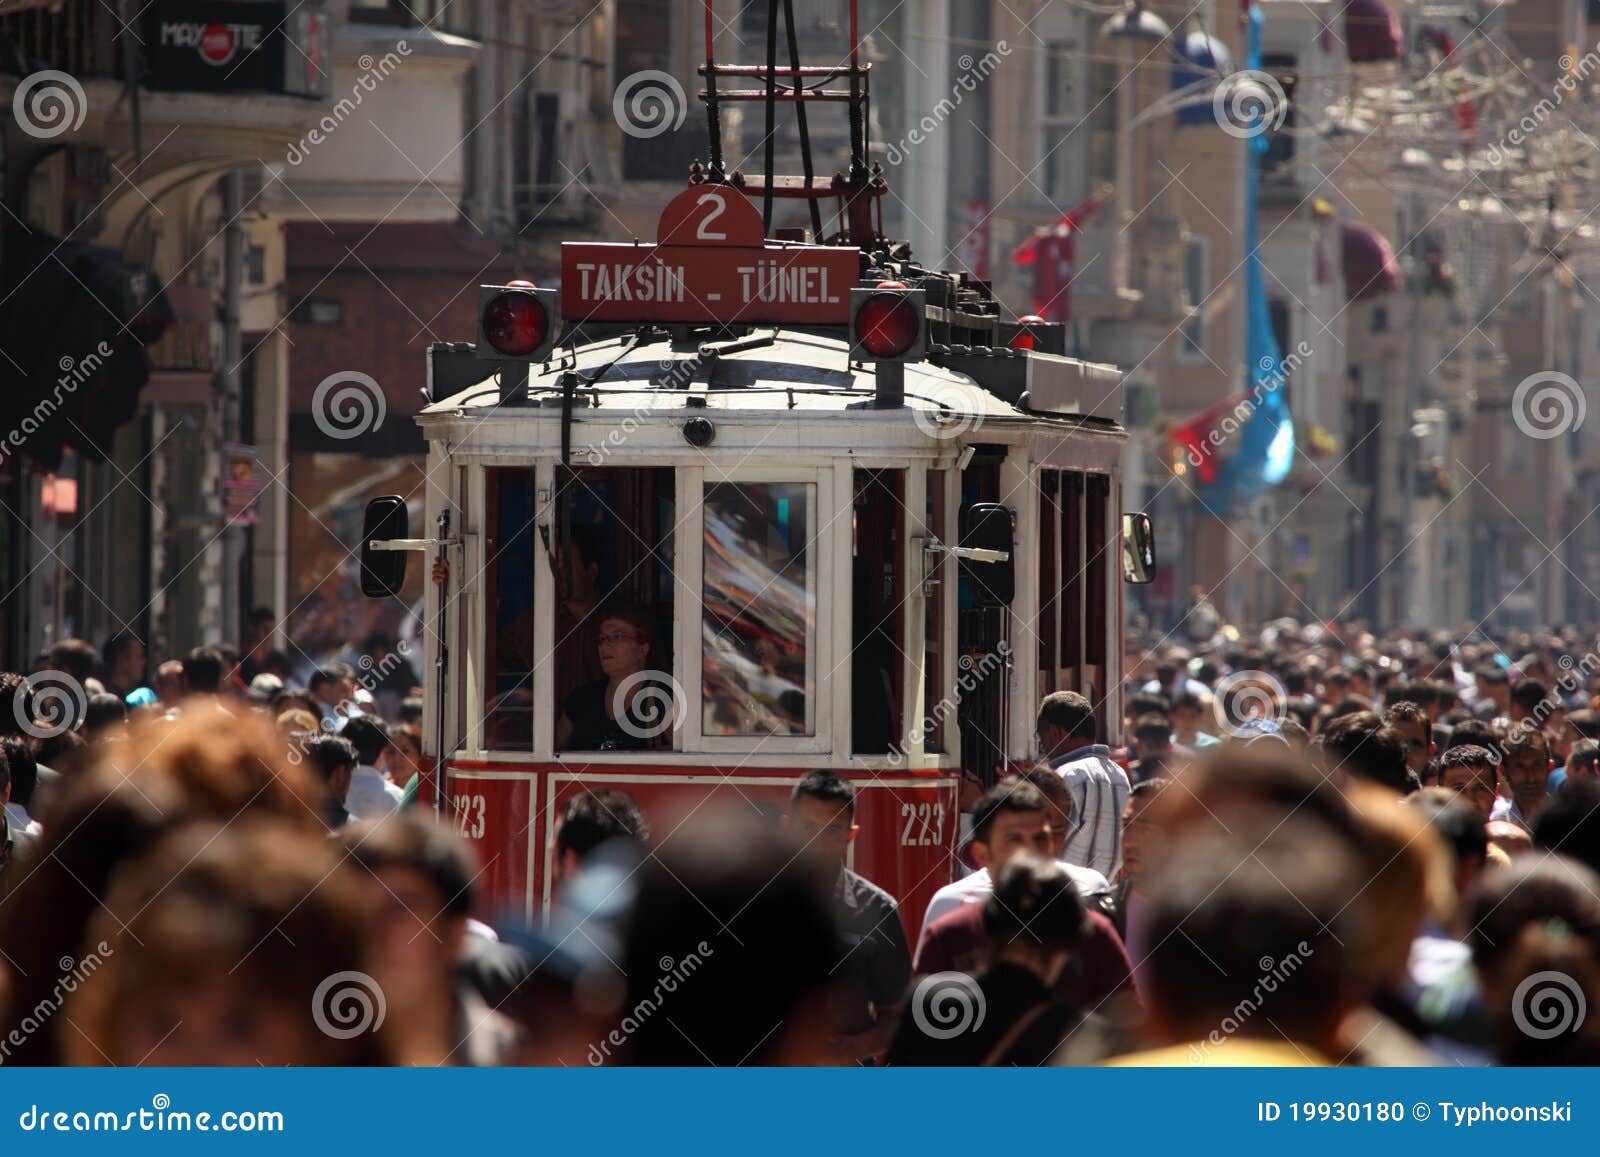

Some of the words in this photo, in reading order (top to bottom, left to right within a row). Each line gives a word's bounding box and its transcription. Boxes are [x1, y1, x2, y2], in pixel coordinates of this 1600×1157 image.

[697, 194, 727, 240] 2
[577, 259, 684, 302] TAKSİM
[738, 260, 839, 303] TÜNEL
[901, 803, 944, 846] 223
